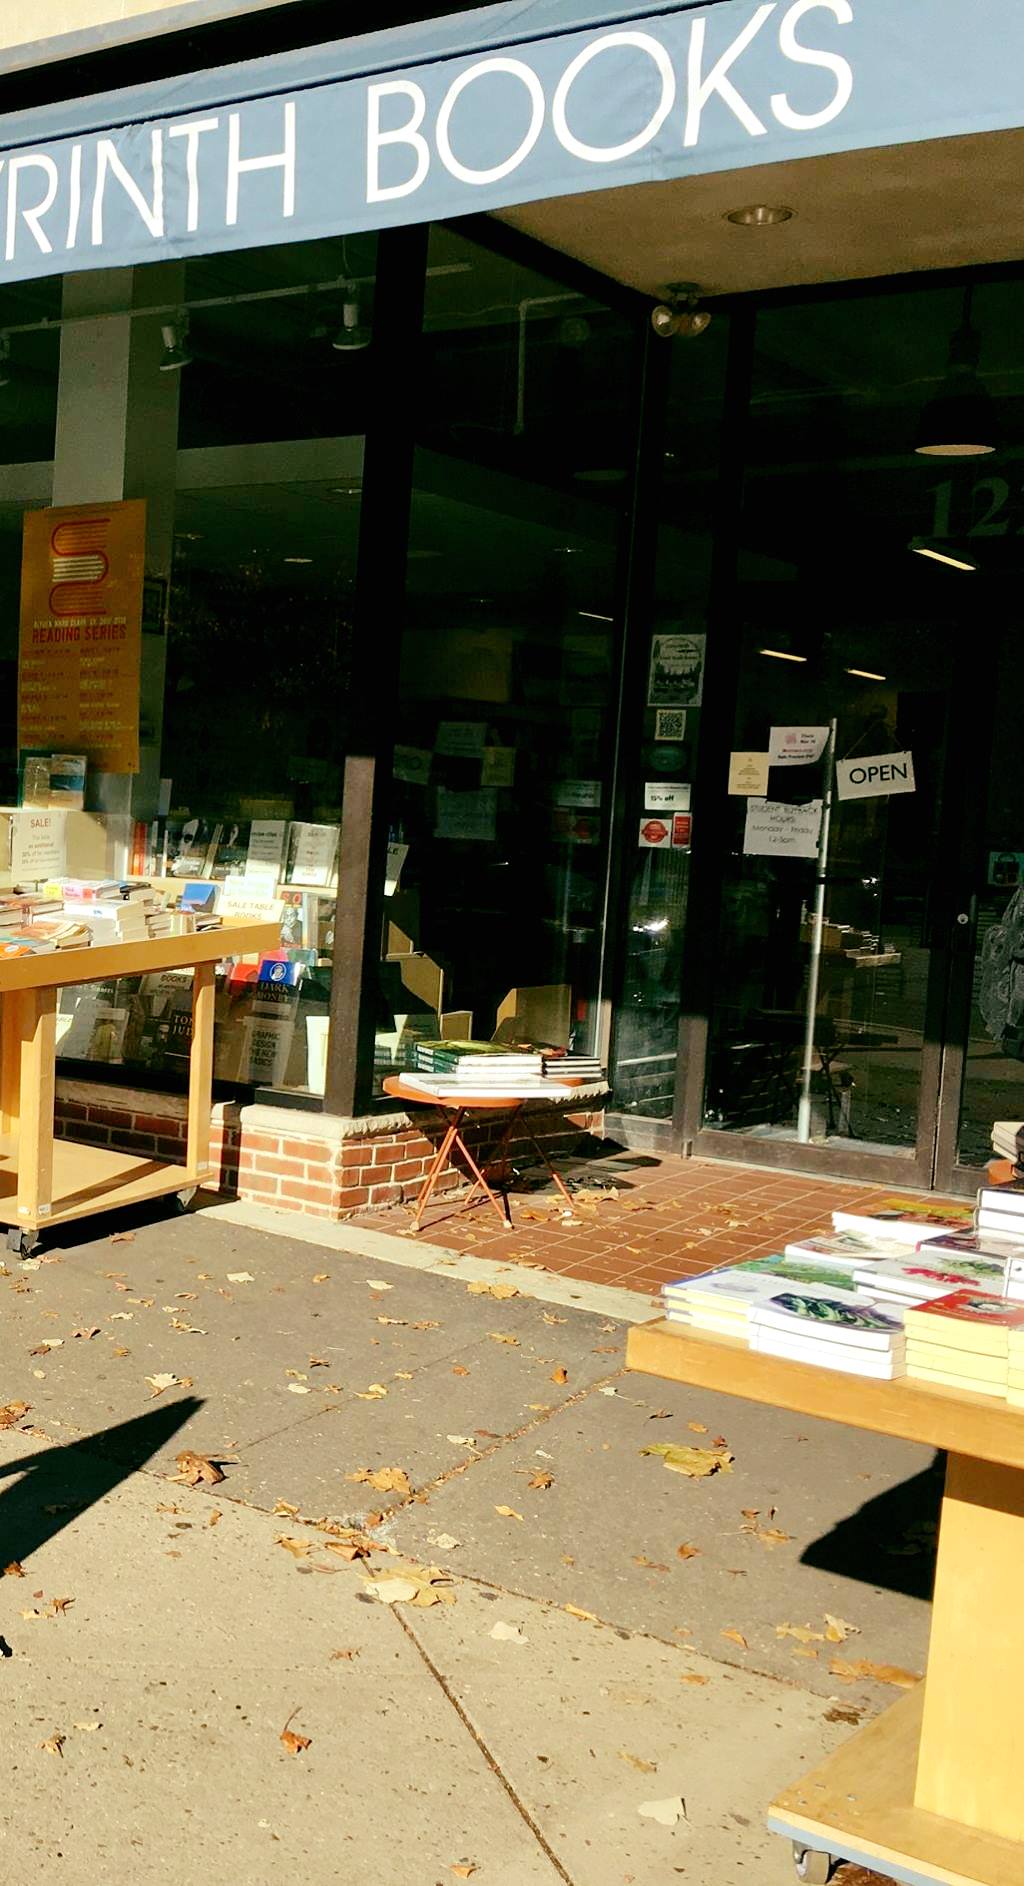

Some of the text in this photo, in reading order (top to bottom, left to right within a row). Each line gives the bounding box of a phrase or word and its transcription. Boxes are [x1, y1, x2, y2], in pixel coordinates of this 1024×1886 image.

[366, 0, 854, 203] BOOKS
[916, 477, 1024, 538] 12
[84, 624, 127, 640] SERIES
[849, 763, 907, 784] OPEN
[30, 817, 52, 829] SALE!
